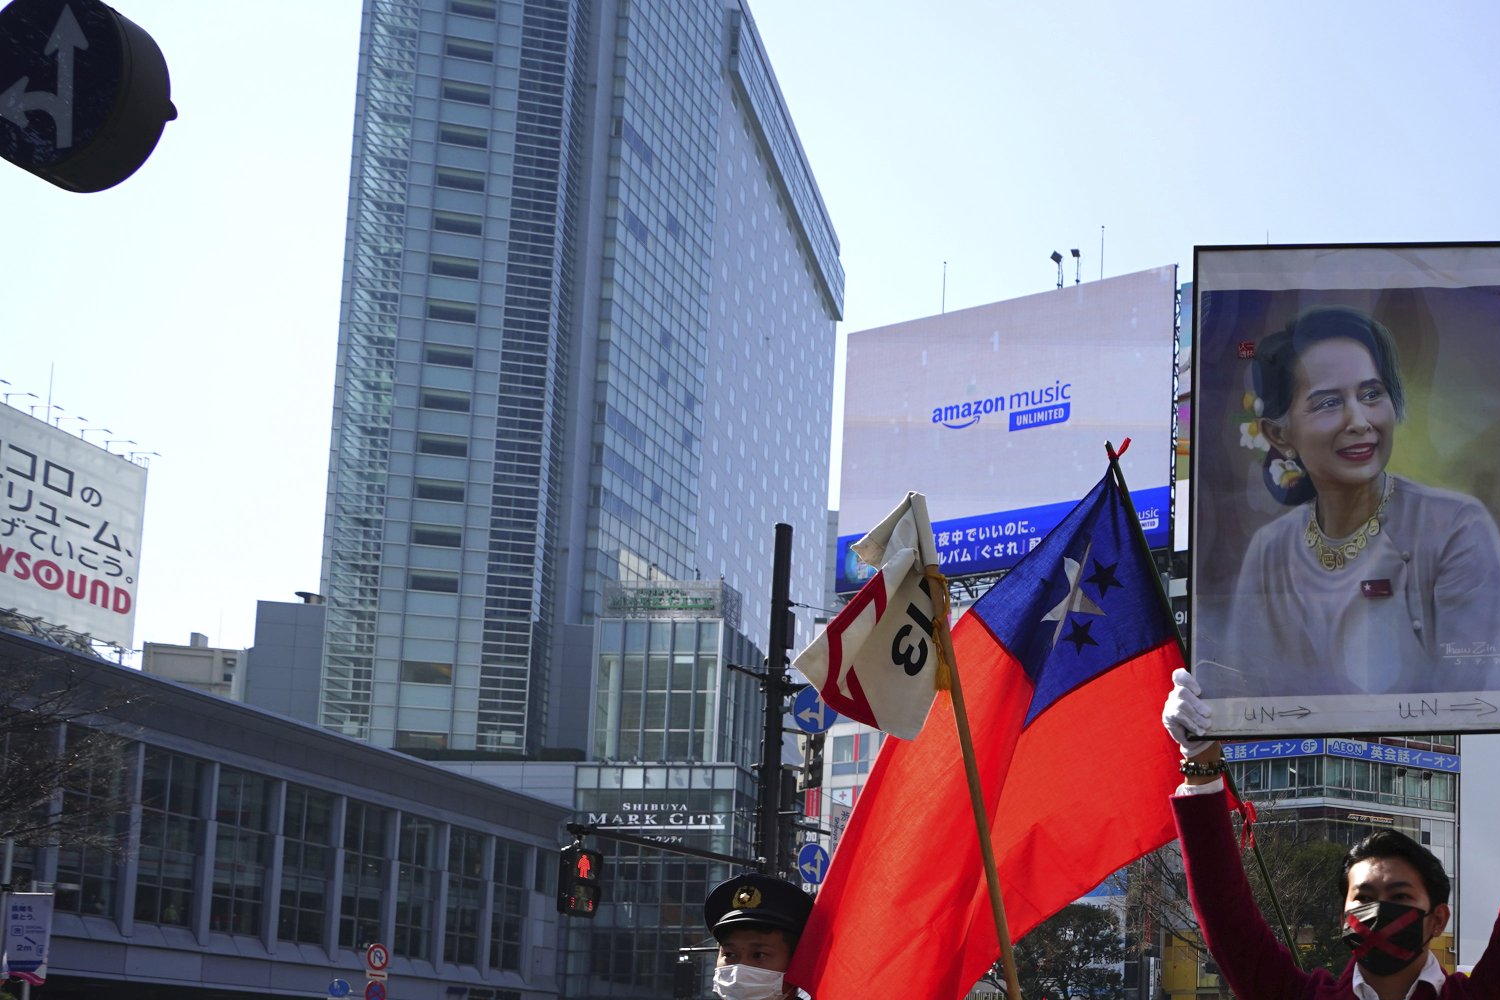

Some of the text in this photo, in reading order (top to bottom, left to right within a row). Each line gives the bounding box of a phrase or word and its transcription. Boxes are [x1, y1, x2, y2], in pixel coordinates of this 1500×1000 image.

[932, 380, 1072, 424] amazon music
[1016, 407, 1065, 426] UNLIMITED
[0, 440, 102, 507] コロの
[0, 474, 133, 558] リューム、
[1302, 741, 1316, 752] 6F
[1333, 741, 1458, 769] AEON 英会話イーオン
[622, 802, 688, 811] SHIBUYA
[588, 813, 726, 825] MARK CITY
